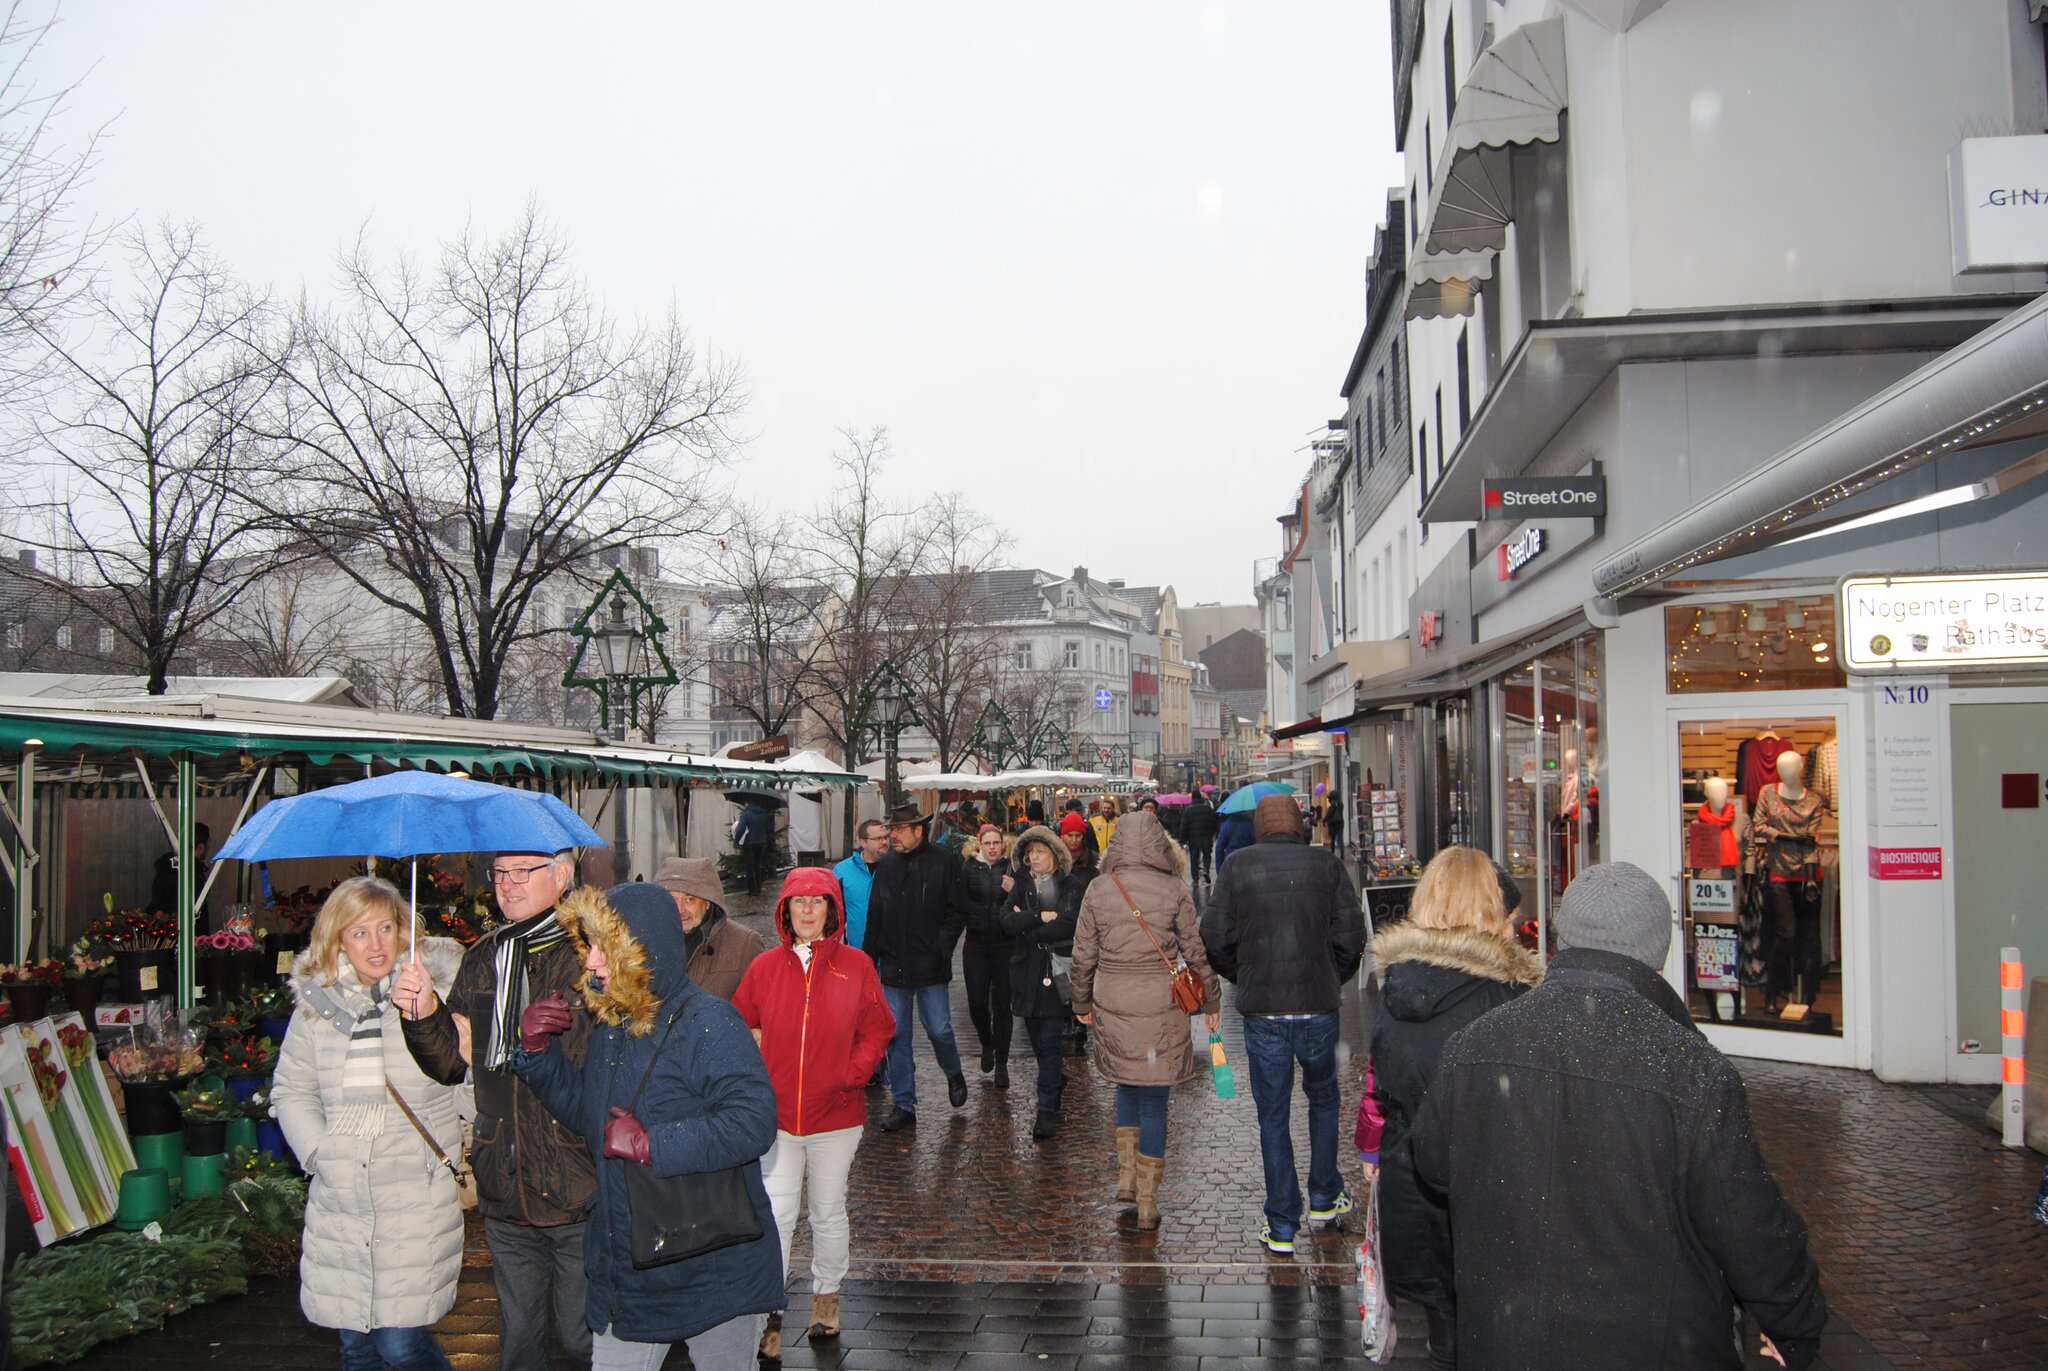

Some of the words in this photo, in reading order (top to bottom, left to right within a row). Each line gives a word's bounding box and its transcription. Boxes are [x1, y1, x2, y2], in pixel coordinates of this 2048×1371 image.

[1989, 188, 2048, 206] GIN
[1503, 490, 1558, 505] Street
[1560, 489, 1597, 503] One
[1507, 537, 1526, 572] Street
[1526, 528, 1540, 558] One
[1859, 597, 1972, 623] Nogenter
[1985, 592, 2045, 613] Platz
[1907, 685, 1929, 704] 10
[1398, 735, 1407, 772] Tradition
[1883, 748, 1931, 757] Hautärztin
[1880, 851, 1940, 864] BIOSTHETIQUE
[1696, 884, 1712, 898] 20
[1715, 885, 1727, 898] %
[1695, 924, 1707, 937] 3.
[1708, 924, 1738, 938] Dez.
[1697, 951, 1736, 966] SONN
[1697, 963, 1724, 975] TAG
